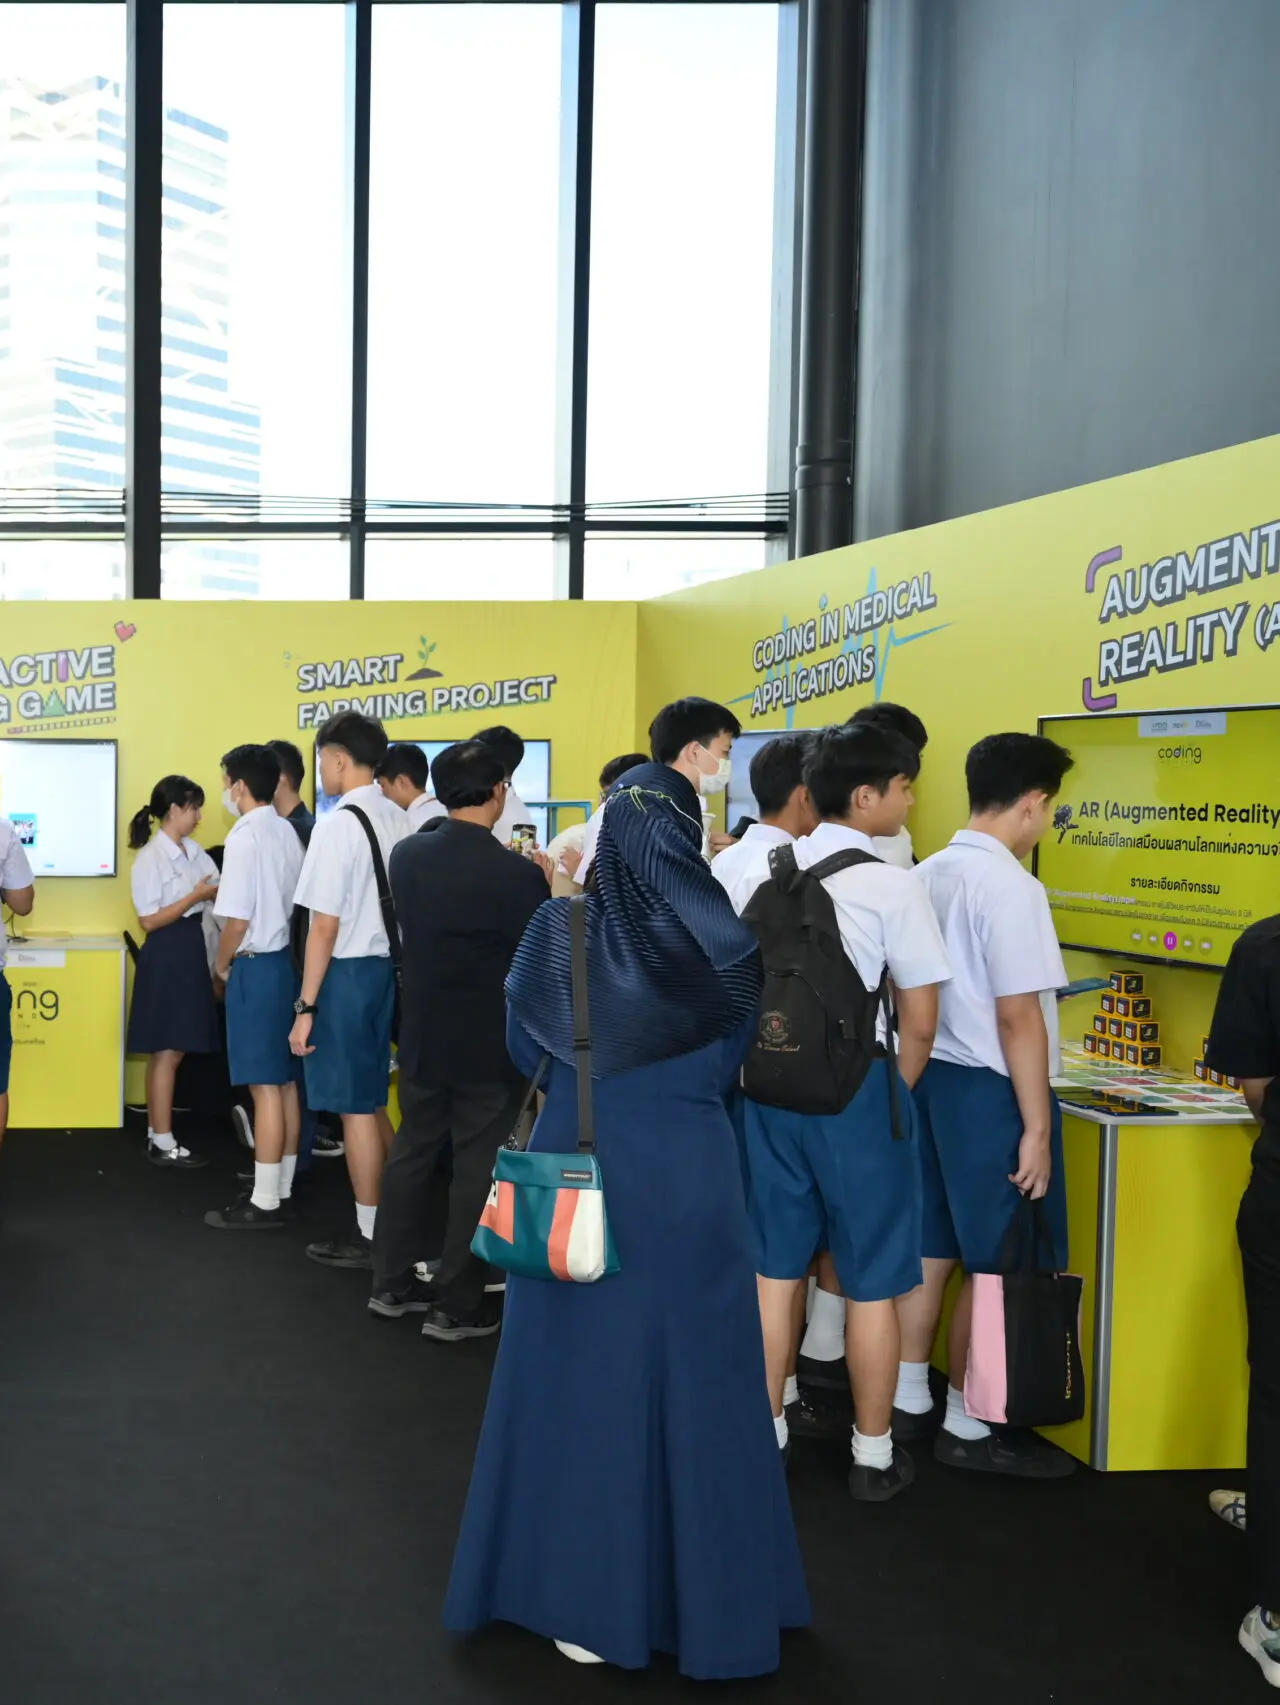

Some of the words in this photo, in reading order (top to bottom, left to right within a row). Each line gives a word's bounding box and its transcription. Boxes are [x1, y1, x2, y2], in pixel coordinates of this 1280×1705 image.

[753, 619, 816, 671] CODING
[843, 573, 936, 636] MEDICAL
[1099, 602, 1249, 687] REALITY
[297, 654, 403, 692] SMART
[751, 645, 875, 716] APPLICATIONS
[17, 682, 115, 719] GAME
[433, 675, 556, 713] PROJECT
[1158, 745, 1202, 764] coding
[1079, 801, 1100, 818] AR
[1104, 800, 1209, 825] (Augmented
[1072, 831, 1280, 856] เทคโนโลยีโลกเสมือนผสานโลกแห่งความจ
[1130, 876, 1220, 895] รายละเอียดกิจกรรม
